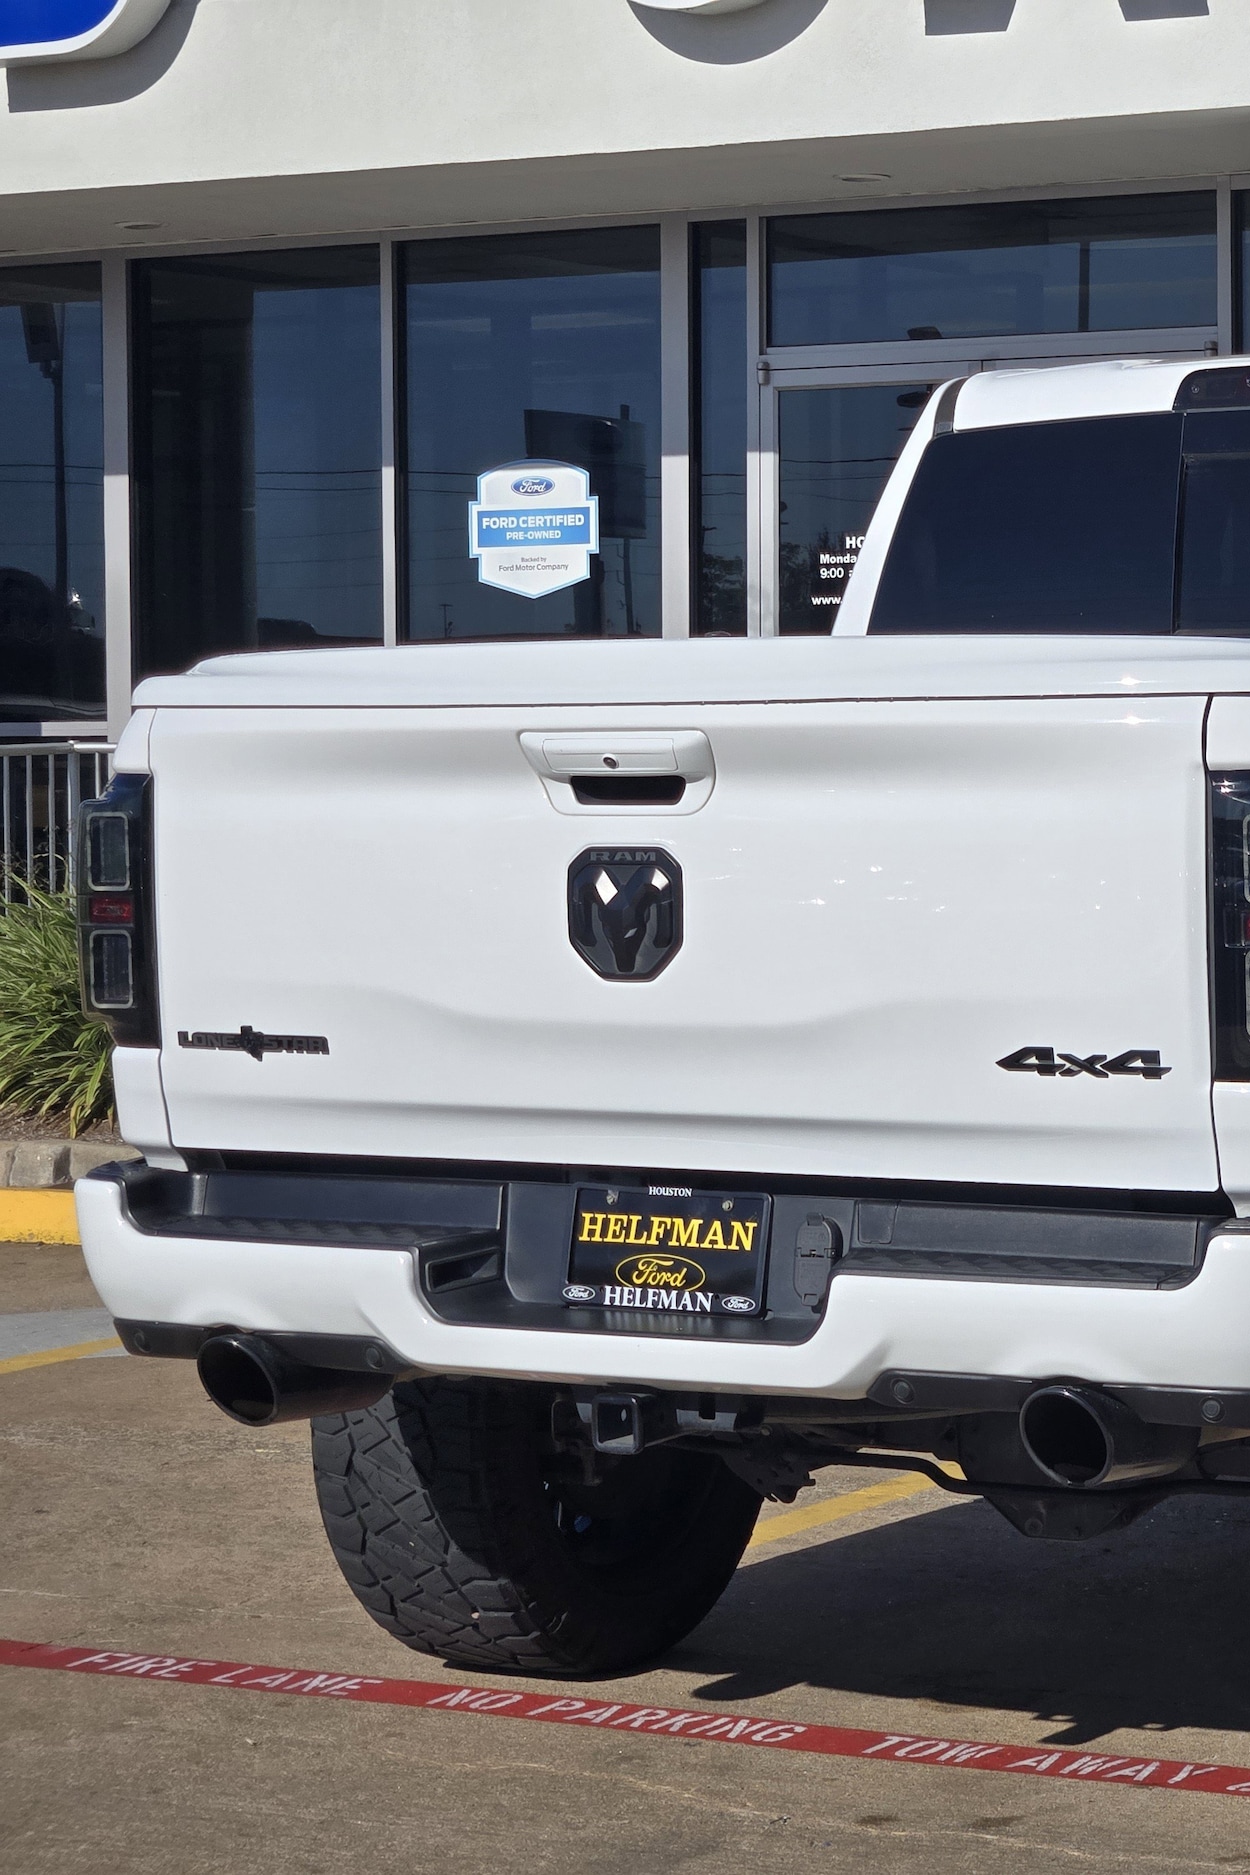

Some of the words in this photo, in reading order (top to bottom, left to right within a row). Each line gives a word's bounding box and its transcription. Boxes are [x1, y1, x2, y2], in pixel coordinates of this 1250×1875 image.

[519, 479, 547, 493] Ford
[482, 517, 517, 529] FORD
[519, 514, 585, 528] CERTIFIED
[506, 530, 562, 541] PRE-OWNED
[498, 565, 514, 573] Ford
[515, 563, 535, 572] Motor
[536, 562, 569, 572] Company
[820, 567, 844, 579] 9:00
[590, 851, 657, 862] RAM
[177, 1031, 239, 1050] LONE
[262, 1035, 330, 1055] STAR
[648, 1186, 692, 1197] HOUSTON
[578, 1212, 758, 1251] HELFMAN
[631, 1258, 688, 1288] Ford
[568, 1286, 589, 1298] Ford
[603, 1285, 714, 1313] HELFMAN
[727, 1299, 750, 1310] Ford
[66, 1651, 216, 1678] FIRE
[210, 1666, 384, 1696] LANE
[426, 1688, 523, 1711] NO
[526, 1698, 808, 1743] PARKING
[861, 1735, 1002, 1764] TOW
[1005, 1752, 1218, 1785] AWAY
